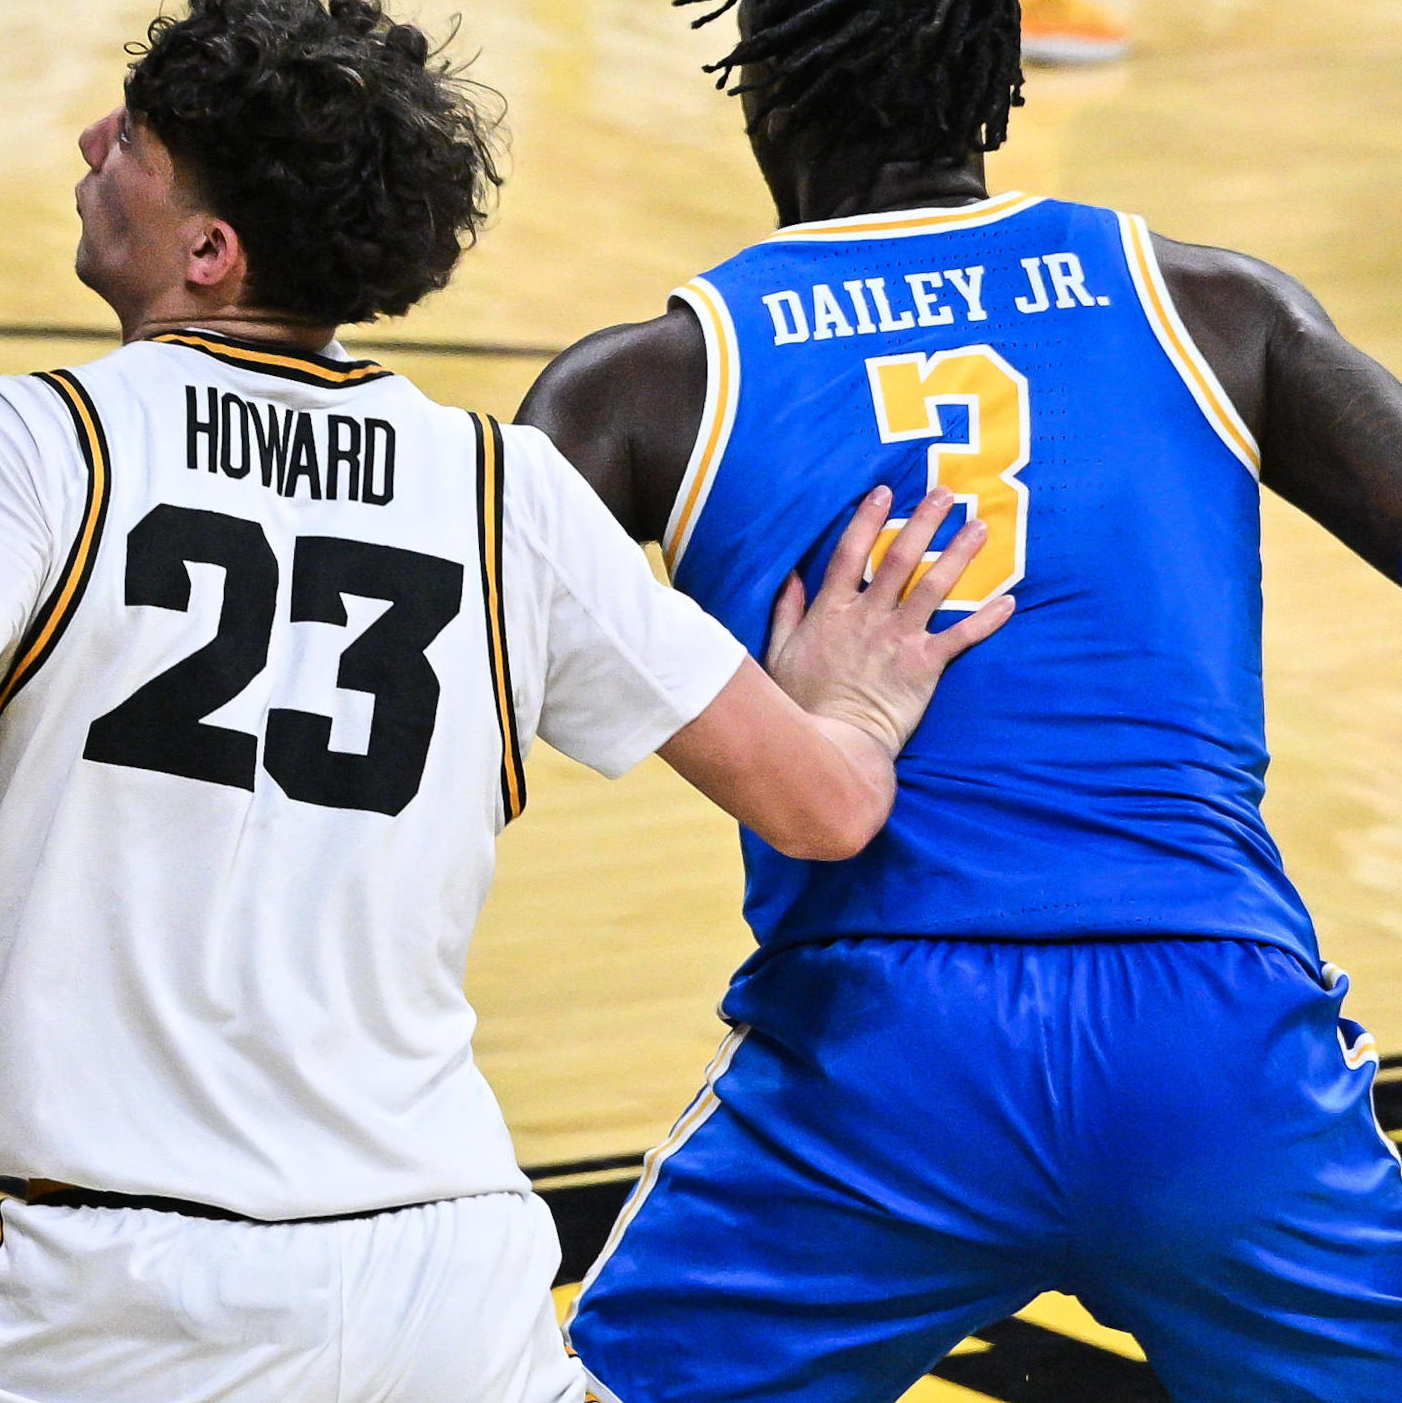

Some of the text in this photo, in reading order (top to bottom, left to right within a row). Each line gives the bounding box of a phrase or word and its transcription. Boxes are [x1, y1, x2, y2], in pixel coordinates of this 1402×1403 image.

[761, 252, 1111, 347] DAILEY JR.
[184, 384, 396, 507] HOWARD
[864, 343, 1032, 612] 3
[82, 502, 465, 818] 23
